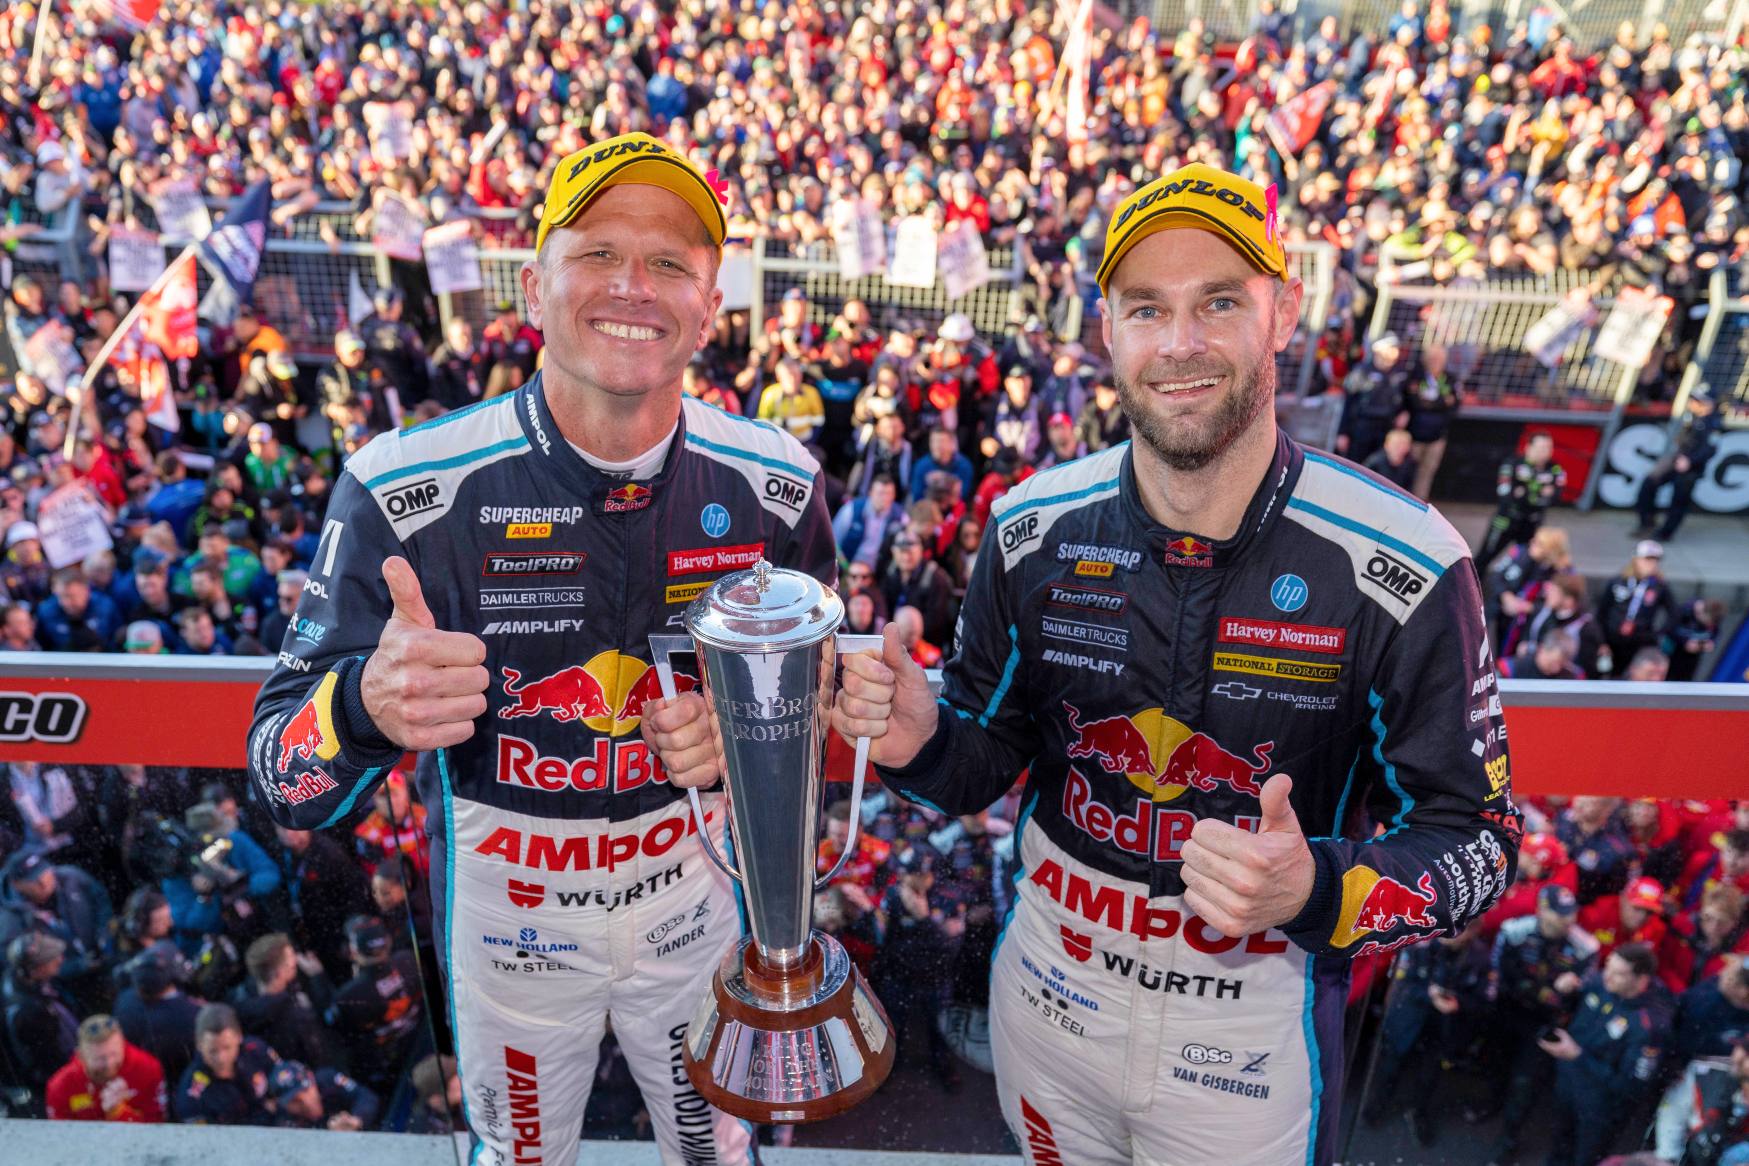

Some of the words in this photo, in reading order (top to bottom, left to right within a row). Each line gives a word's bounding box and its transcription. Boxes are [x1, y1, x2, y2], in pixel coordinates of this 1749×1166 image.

[1113, 179, 1266, 233] DUNLOP
[526, 393, 552, 457] AMPOL
[386, 483, 440, 516] OMP
[765, 477, 806, 507] OMP
[479, 506, 583, 525] SUPERCHEAP
[512, 526, 548, 536] AUTO
[1003, 516, 1038, 549] OMP
[673, 554, 715, 571] Harvey
[716, 551, 761, 566] Norman
[1057, 543, 1142, 569] SUPERCHEAP
[1078, 563, 1109, 574] AUTO
[1367, 556, 1423, 595] OMP
[498, 619, 585, 635] AMPLIFY
[1226, 622, 1278, 643] Harvey
[1280, 627, 1339, 648] Norman
[1050, 650, 1125, 676] AMPLIFY
[1216, 656, 1274, 672] NATIONAL
[1277, 663, 1336, 679] STORAGE
[1267, 691, 1336, 705] CHEVROLET
[496, 733, 611, 792] Red
[614, 740, 669, 793] Bu
[279, 774, 313, 806] Red
[302, 766, 340, 799] Bull
[1062, 764, 1152, 855] Red
[473, 808, 713, 873] AMPOL
[556, 863, 684, 913] WÜRTH
[1030, 858, 1290, 955] AMPOL
[482, 934, 513, 947] NEW
[516, 941, 578, 953] HOLLAND
[655, 924, 705, 958] TANDER
[491, 959, 517, 972] TW
[1101, 950, 1244, 1000] WÜRTH
[1021, 985, 1040, 1007] TW
[1022, 956, 1042, 980] NEW
[1044, 975, 1099, 1012] HOLLAND
[1174, 1066, 1198, 1083] VAN
[1201, 1074, 1270, 1100] GISBERGEN
[506, 1071, 543, 1166] AMPLI
